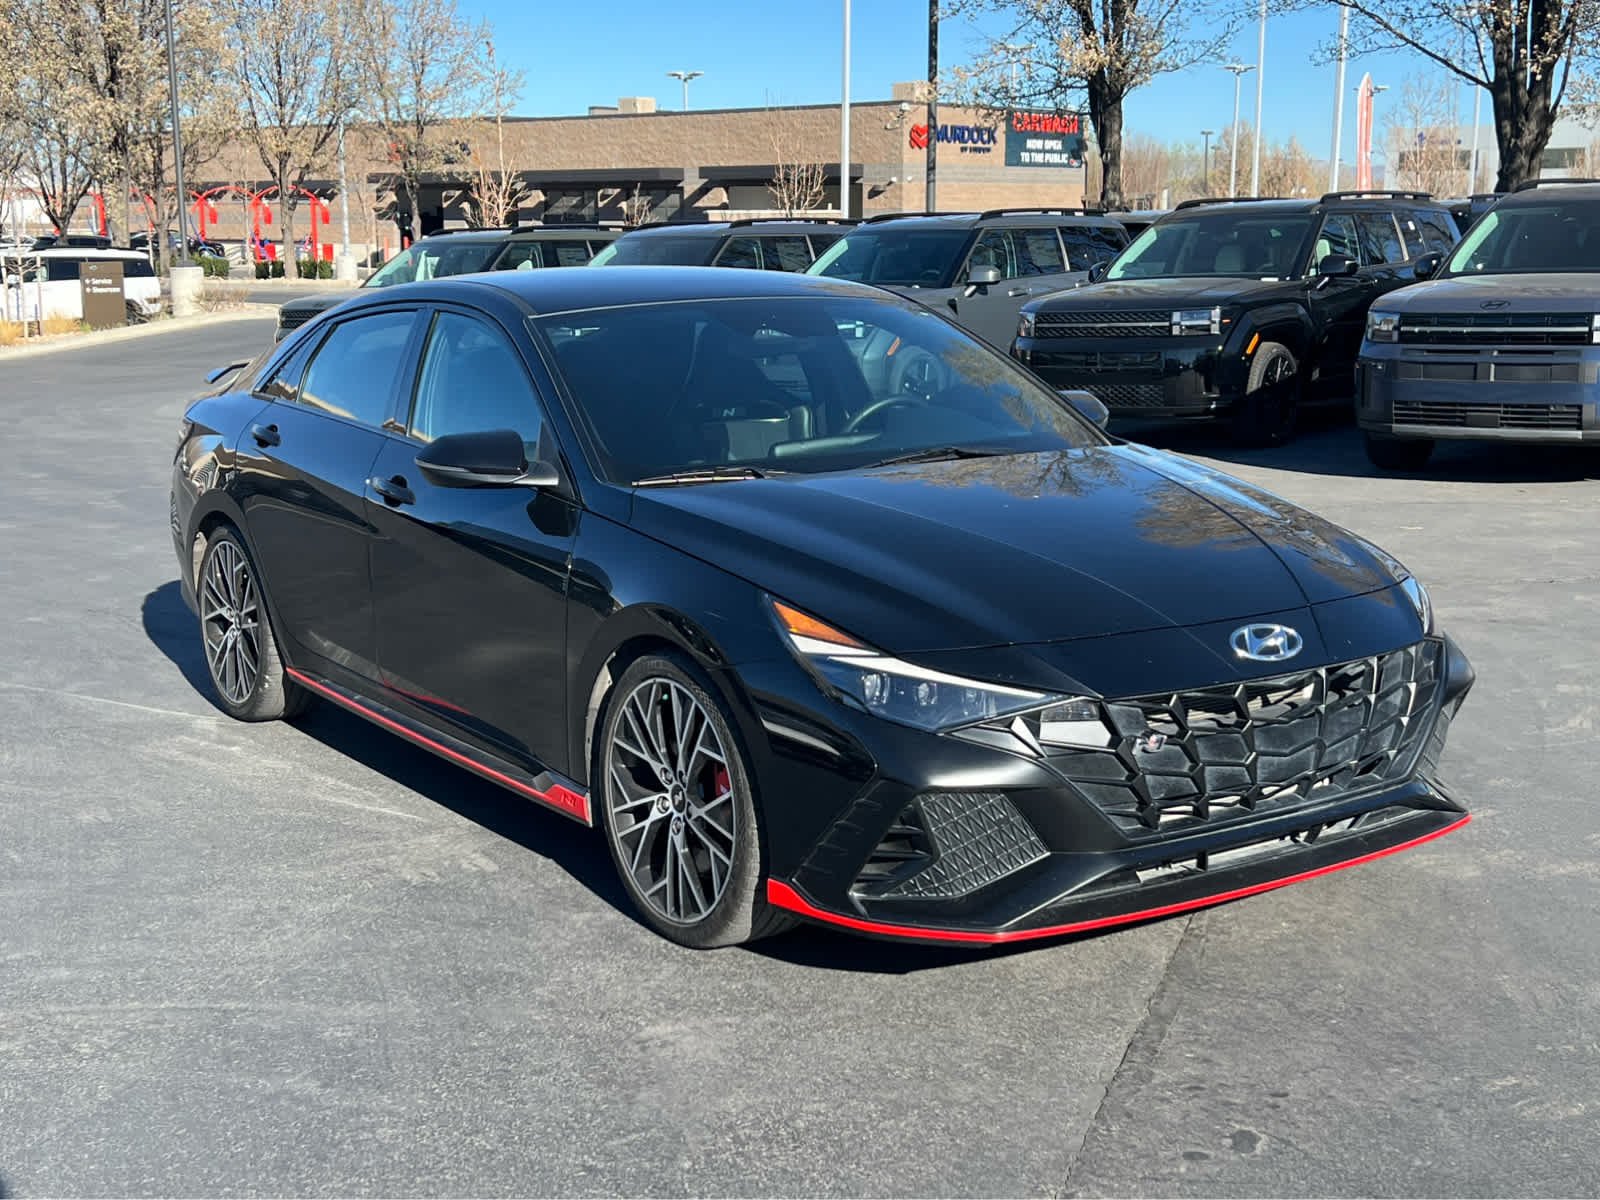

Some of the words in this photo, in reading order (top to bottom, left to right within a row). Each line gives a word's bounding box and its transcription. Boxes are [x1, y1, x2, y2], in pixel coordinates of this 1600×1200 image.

[936, 124, 997, 145] MURDOCK
[1026, 139, 1043, 150] NOW
[1044, 139, 1062, 150] OPEN
[1020, 152, 1030, 163] TO
[1031, 152, 1044, 163] THE
[1044, 153, 1068, 164] PUBLIC
